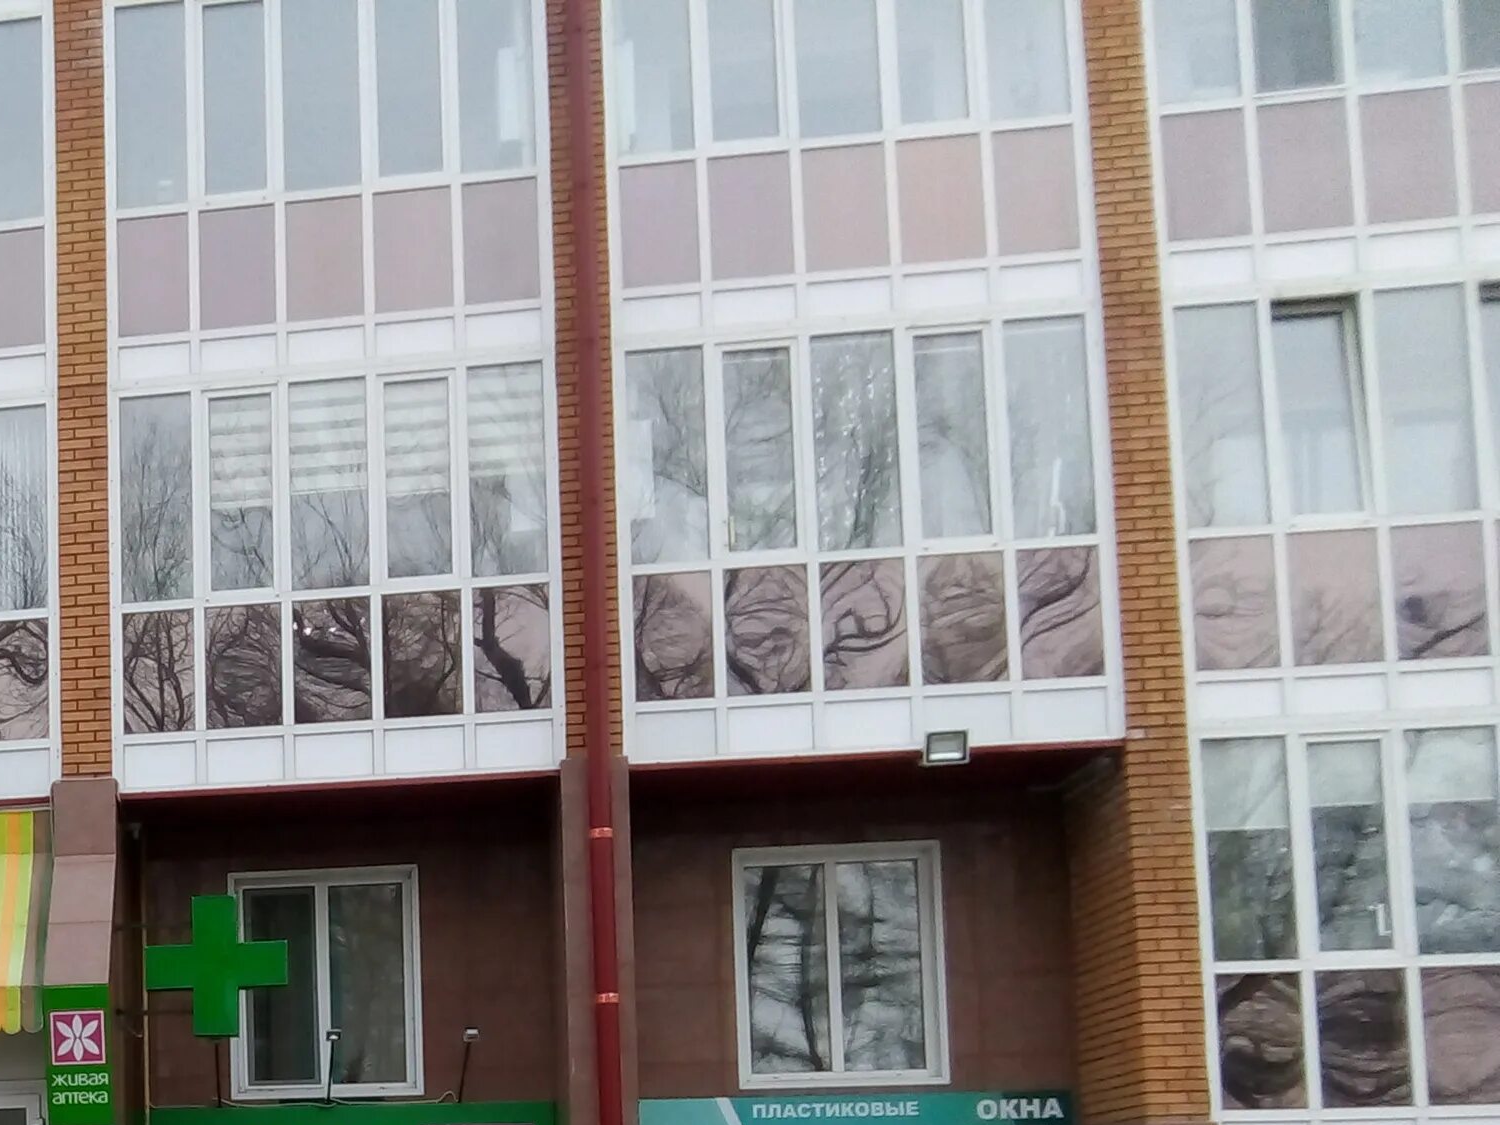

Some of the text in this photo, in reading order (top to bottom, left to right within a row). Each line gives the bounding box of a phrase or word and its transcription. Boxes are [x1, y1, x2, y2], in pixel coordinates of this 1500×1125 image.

[51, 1072, 109, 1087] живая
[51, 1090, 109, 1105] аптека
[752, 1097, 1064, 1120] ПЛАСТИКОВЫЕ ОКНА
